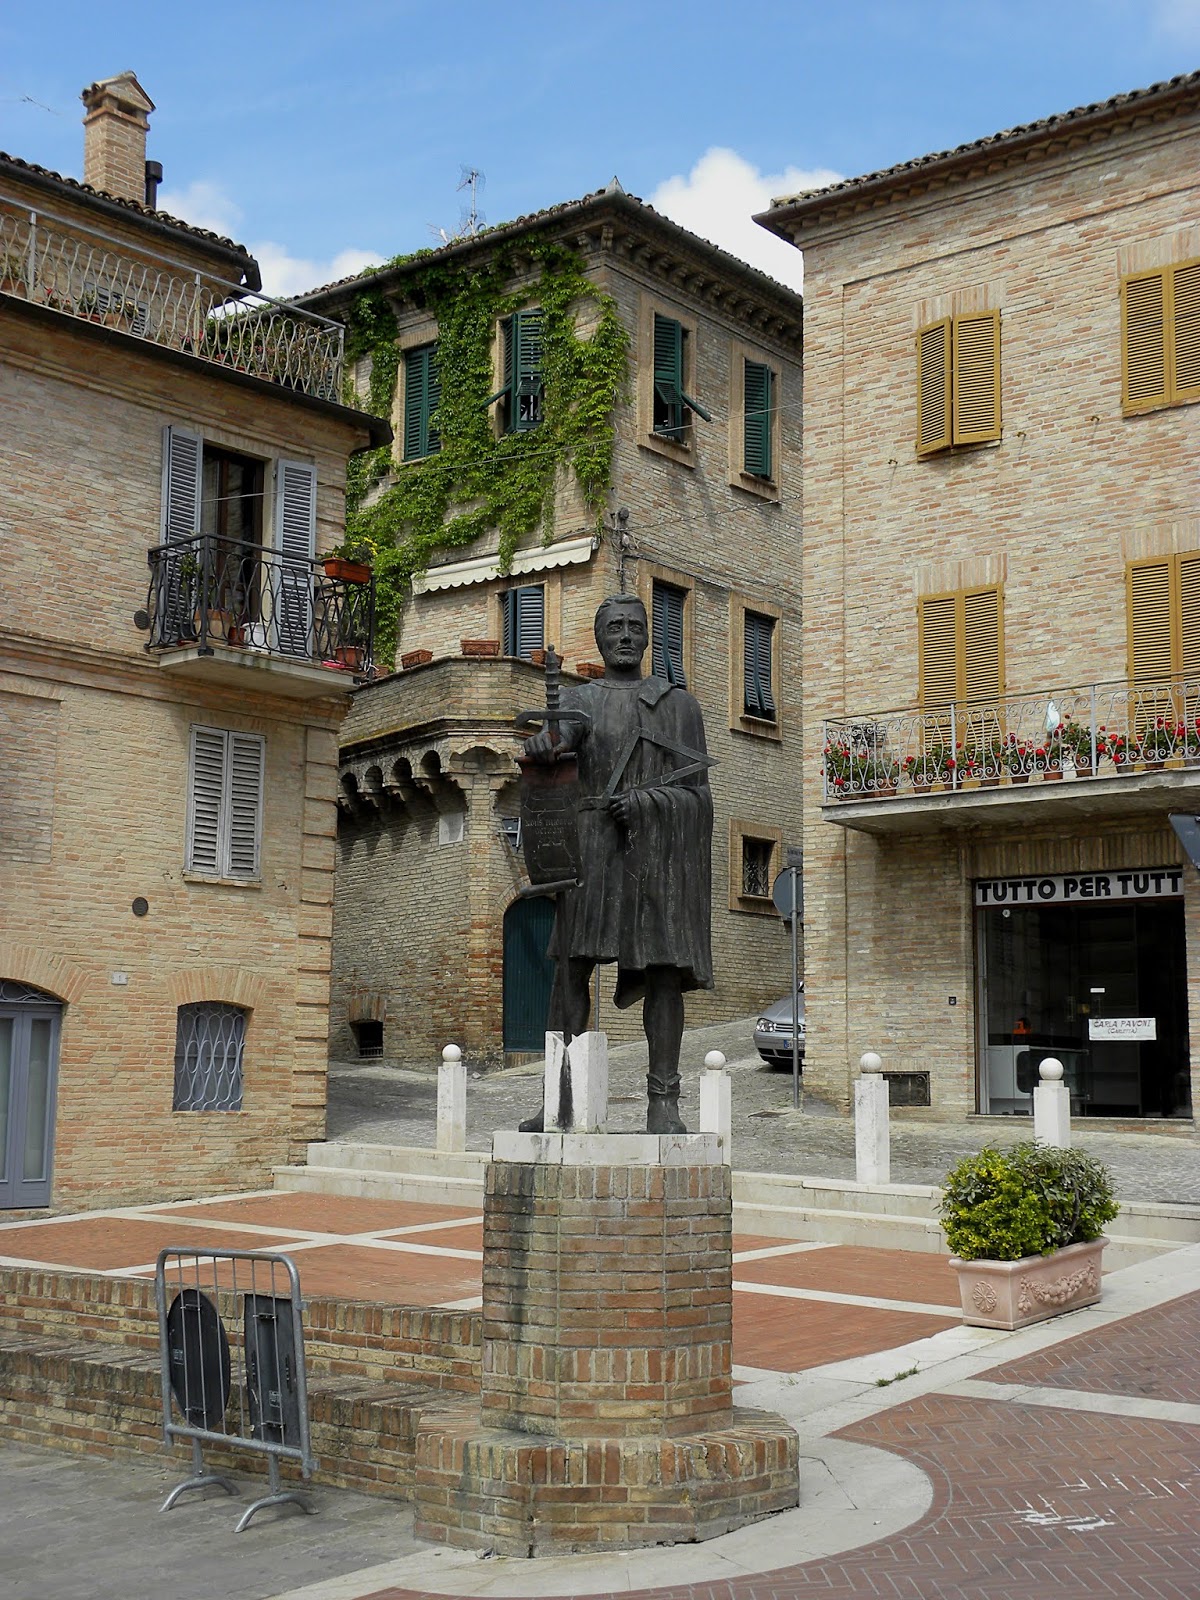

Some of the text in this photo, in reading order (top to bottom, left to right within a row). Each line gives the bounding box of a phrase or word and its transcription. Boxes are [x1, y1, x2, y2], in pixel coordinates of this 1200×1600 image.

[978, 880, 1056, 902] TUTTO
[1064, 877, 1110, 898] PER
[1094, 1019, 1152, 1028] CARLA PAVONI
